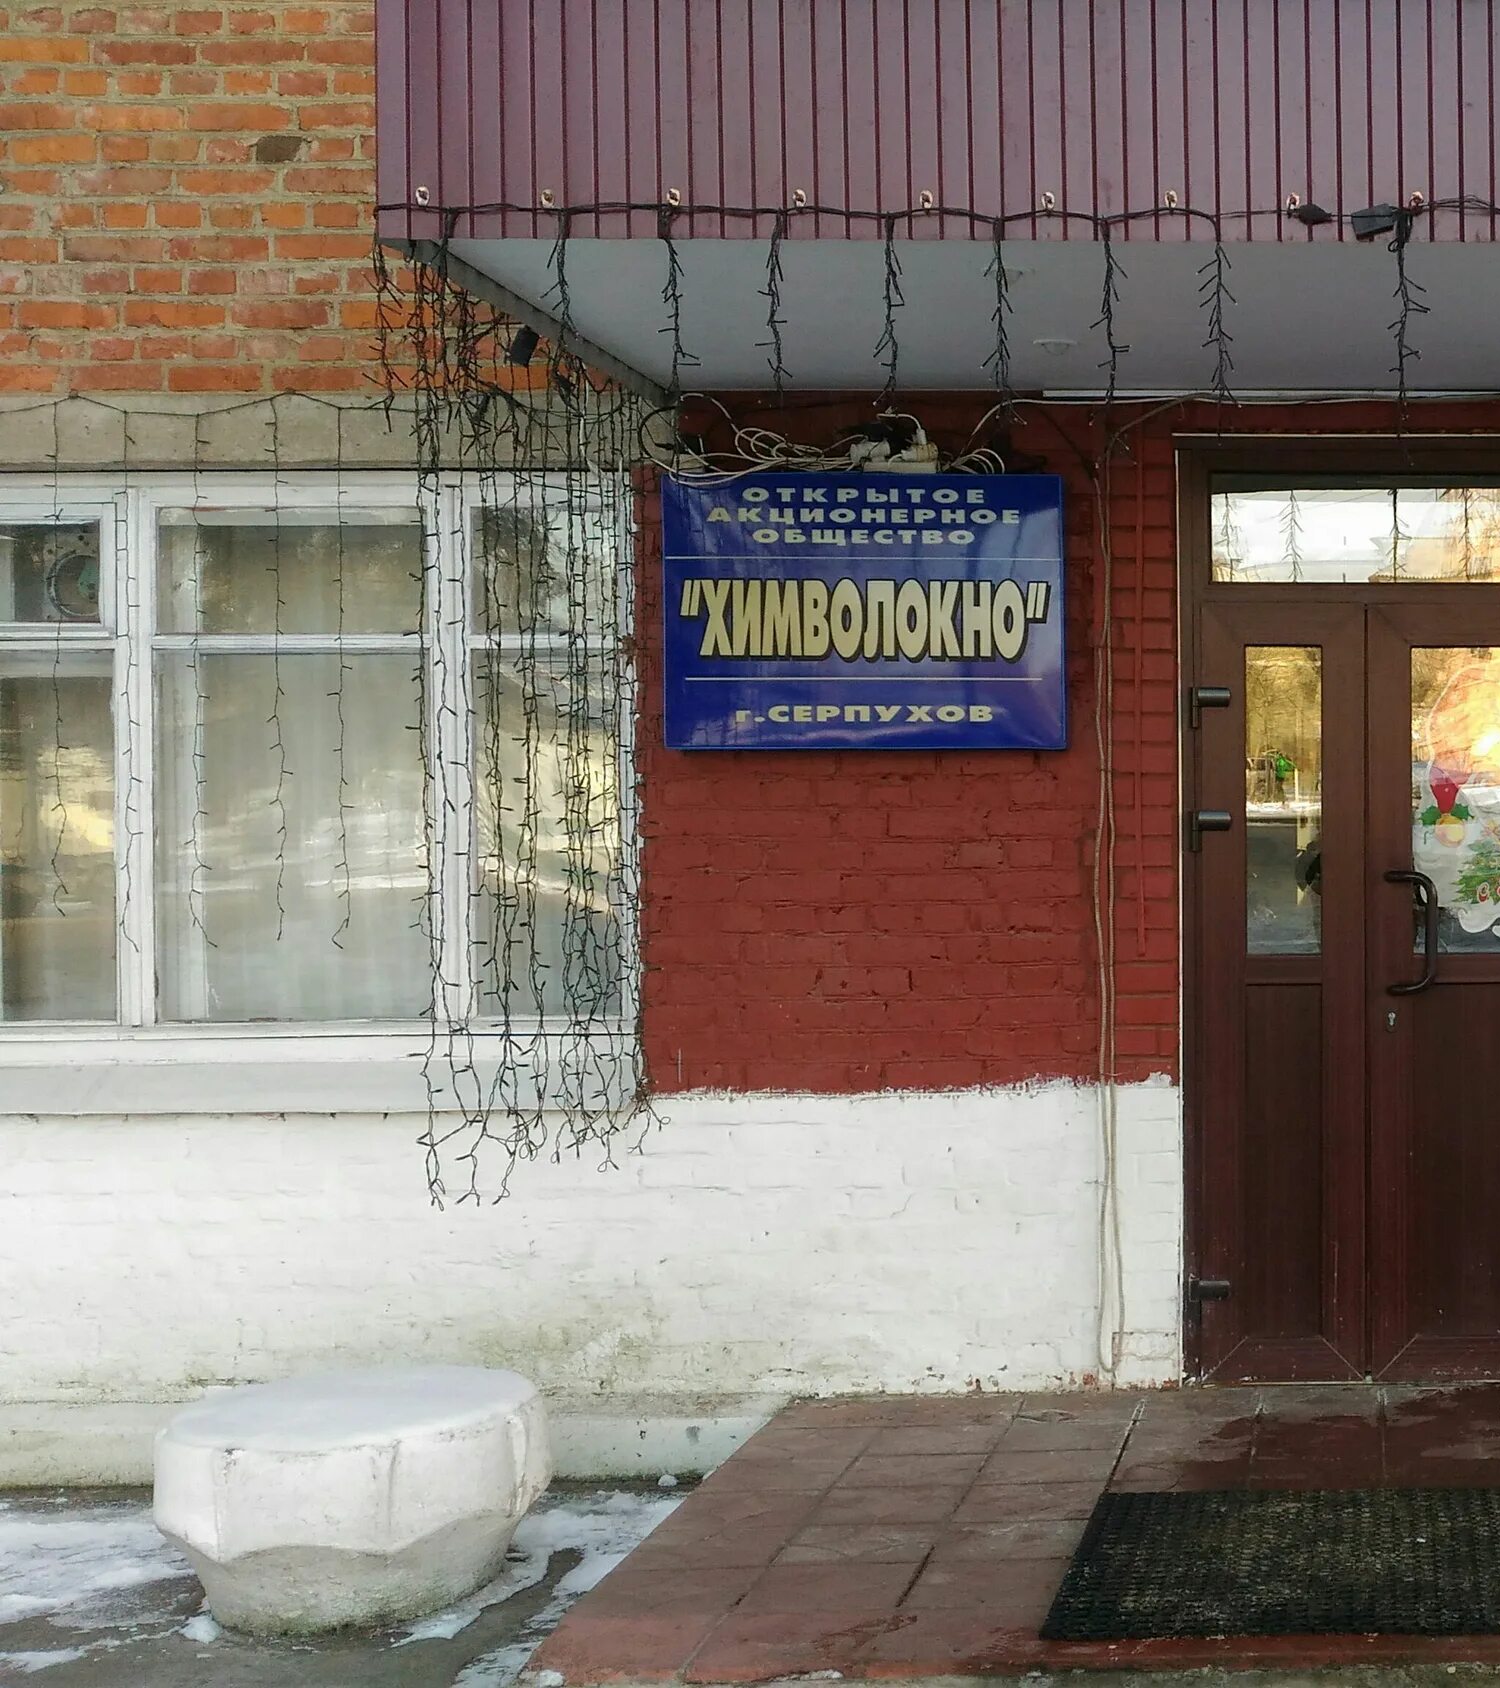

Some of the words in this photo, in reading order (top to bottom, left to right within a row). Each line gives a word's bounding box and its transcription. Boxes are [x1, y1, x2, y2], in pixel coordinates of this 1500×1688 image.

[742, 487, 985, 504] ОТКРЫТОЕ
[706, 507, 1020, 525] АКЦИОНЕРНОЕ
[752, 529, 975, 546] ОБЩЕСТВО
[680, 578, 1051, 662] "ХИМВОЛОКНО"
[735, 704, 993, 723] г.СЕРПУХОВ
